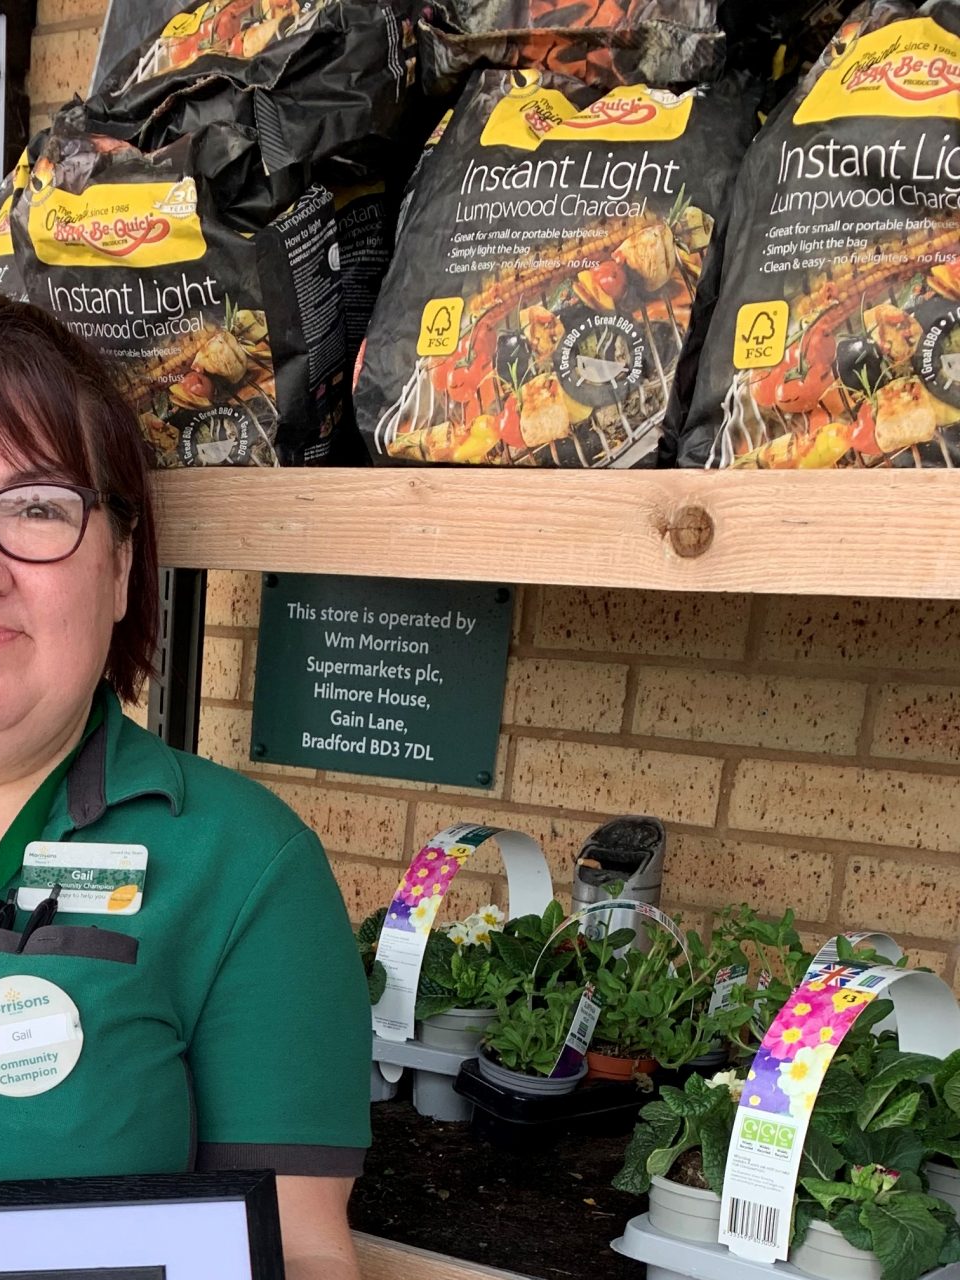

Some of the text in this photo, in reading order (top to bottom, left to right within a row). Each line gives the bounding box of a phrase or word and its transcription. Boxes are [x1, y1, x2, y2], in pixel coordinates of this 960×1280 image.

[519, 100, 563, 125] Origin
[777, 133, 960, 193] Instant Lig
[460, 150, 681, 201] Instant Light
[169, 203, 197, 213] YEARS
[455, 192, 647, 225] Lumpwood Charcoal
[769, 183, 960, 216] Lumpwood Charc
[89, 207, 110, 217] since
[275, 201, 315, 233] Lumpwood
[284, 219, 321, 249] How to light
[454, 232, 476, 243] Great
[477, 230, 488, 241] for
[489, 229, 511, 240] small
[511, 230, 521, 239] or
[521, 227, 560, 241] portable
[769, 227, 793, 239] Great
[794, 223, 810, 235] for
[811, 220, 841, 234] small
[842, 222, 854, 231] or
[856, 219, 904, 233] portable
[450, 245, 531, 260] Simply light the bag
[766, 237, 868, 257] Simply light the bag
[449, 262, 470, 274] Clean
[470, 261, 477, 271] &
[478, 262, 496, 273] easy
[501, 260, 514, 270] no
[567, 259, 580, 269] no
[580, 258, 601, 270] fuss
[764, 260, 791, 274] Clean
[792, 258, 801, 269] &
[801, 257, 826, 271] easy
[833, 255, 849, 265] no
[917, 254, 933, 262] no
[934, 251, 958, 263] fuss
[47, 272, 221, 321] Instant Light
[62, 311, 205, 341] umpwood Charcoal
[593, 315, 616, 326] Great
[616, 317, 633, 334] BBQ
[426, 336, 449, 348] FSC
[563, 328, 581, 349] BBQ
[922, 325, 943, 352] BBQ
[745, 346, 773, 360] FSC
[920, 352, 934, 377] Great
[287, 602, 477, 636] This store is operated by
[324, 631, 430, 655] Wm Morrison
[306, 655, 444, 686] Supermarkets plc,
[313, 682, 431, 711] Hilmore House,
[330, 709, 409, 735] Gain Lane,
[301, 731, 435, 761] Bradford BD3 7DL
[47, 881, 115, 890] Comunity Champion
[71, 870, 94, 881] Gail
[11, 1029, 33, 1042] Gail
[0, 1067, 58, 1085] Champion
